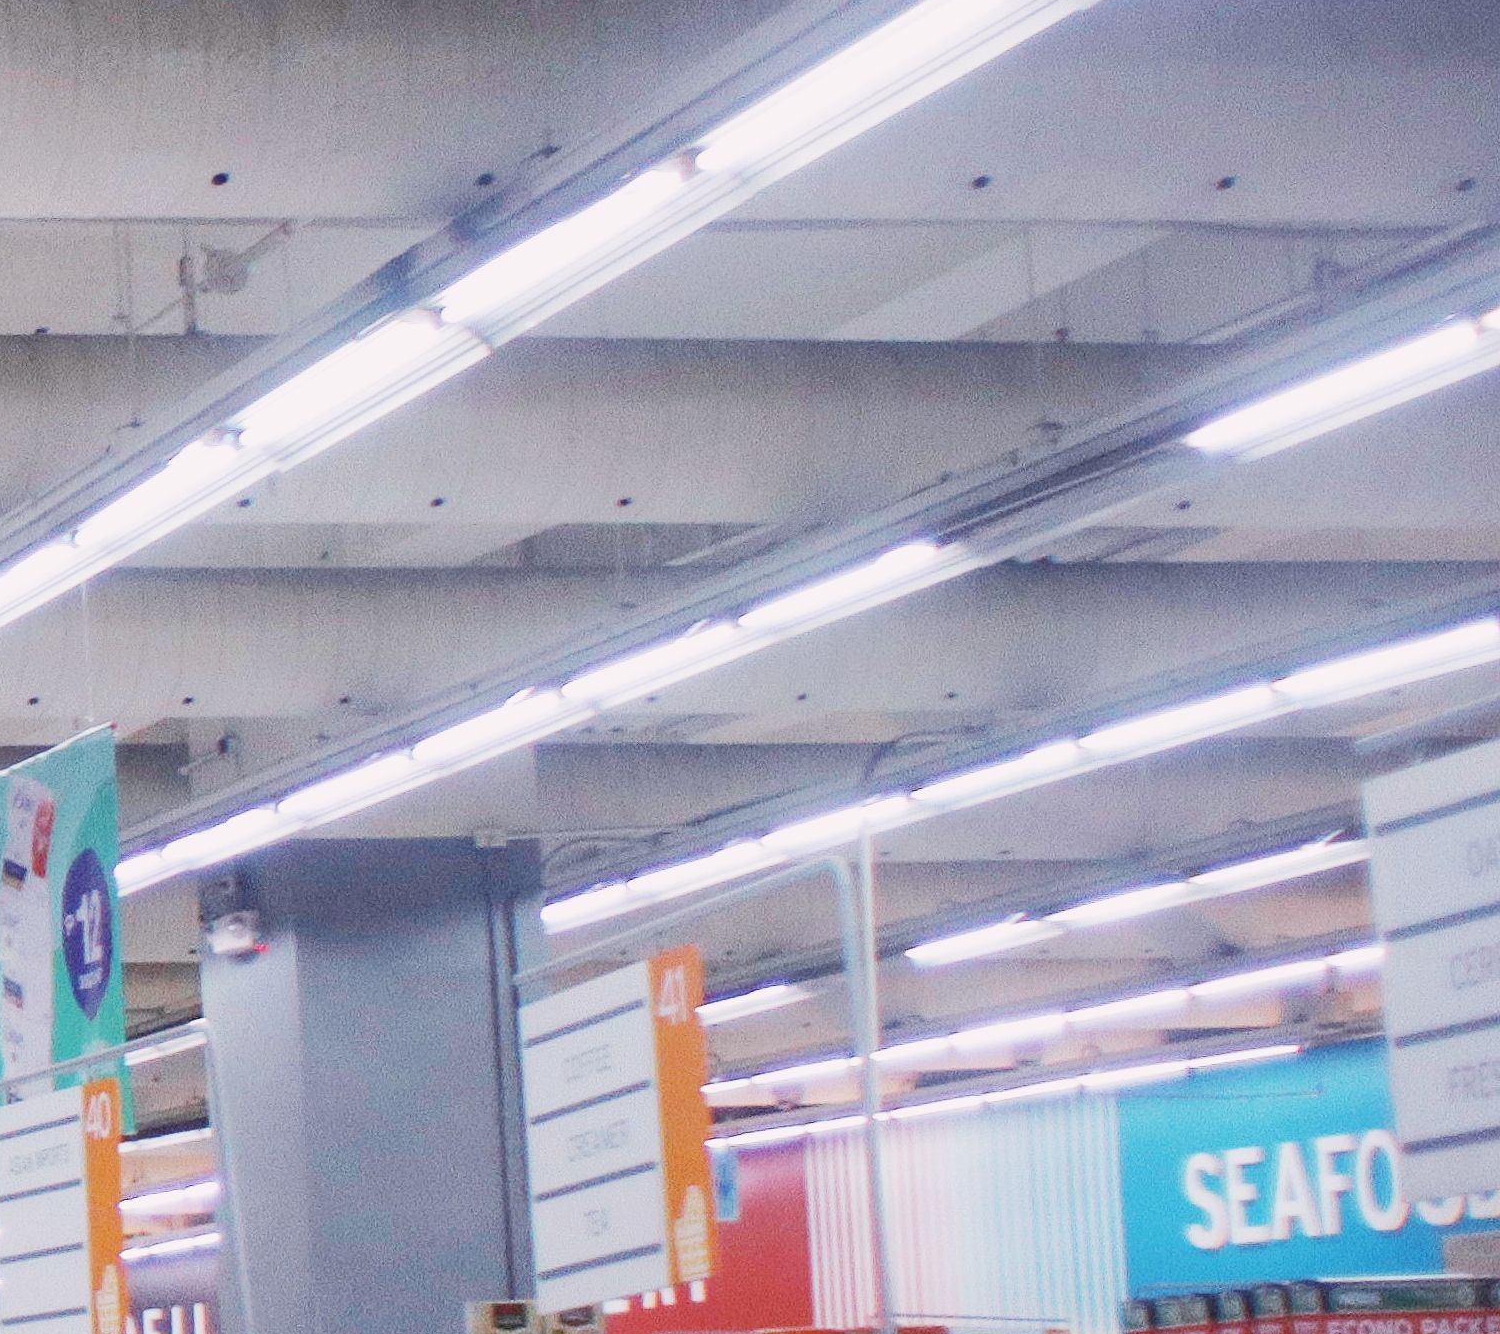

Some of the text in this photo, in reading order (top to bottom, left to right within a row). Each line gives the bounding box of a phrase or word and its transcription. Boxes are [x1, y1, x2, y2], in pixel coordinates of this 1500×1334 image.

[657, 964, 689, 1026] 41
[86, 1092, 112, 1140] 40
[1184, 1128, 1500, 1251] SEAFO
